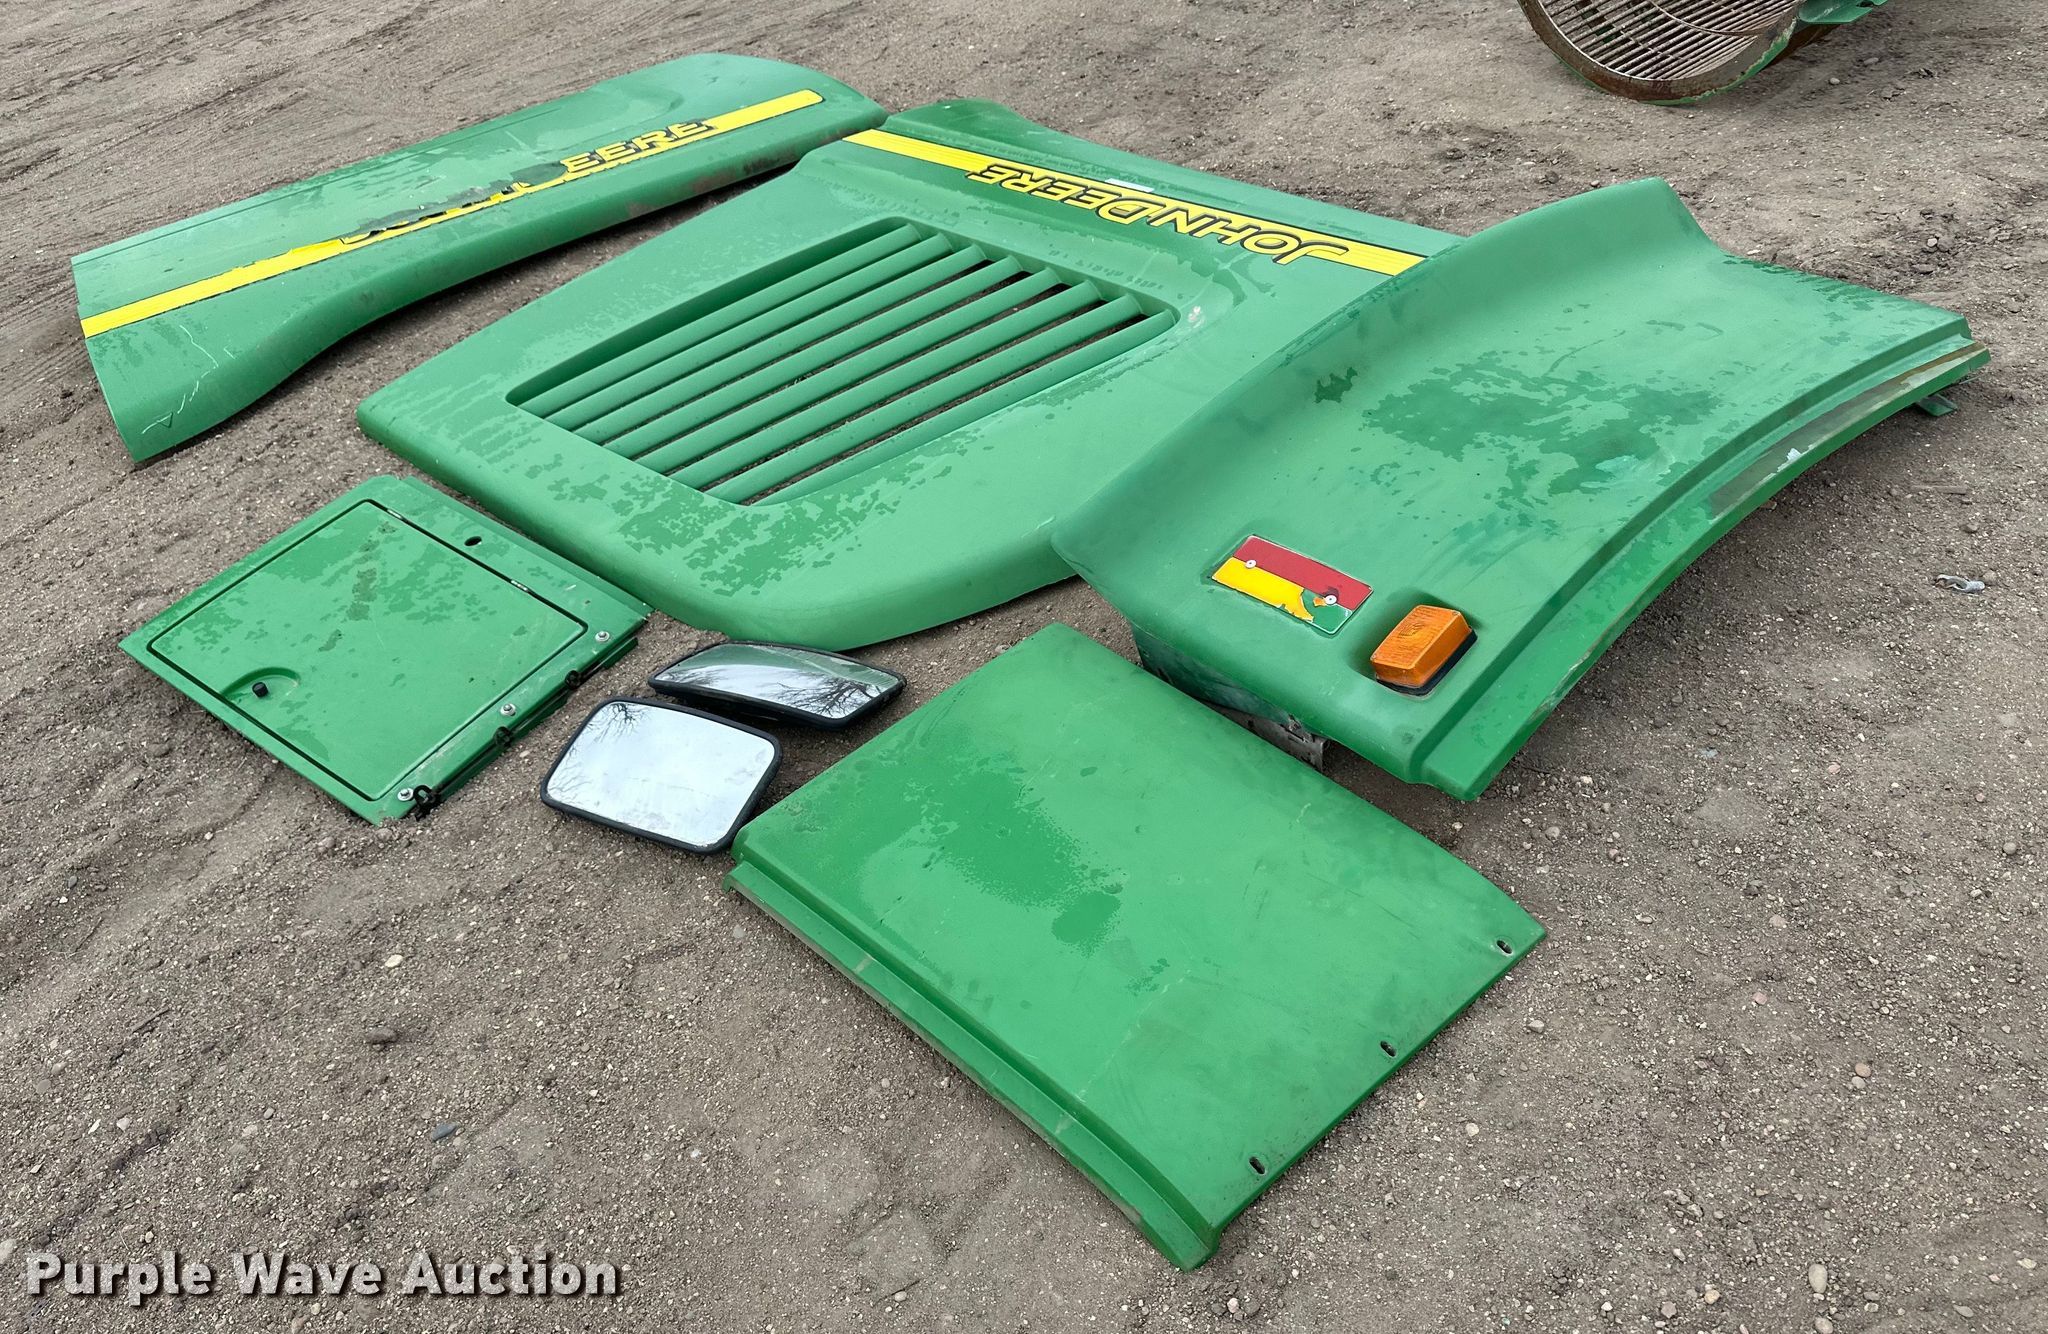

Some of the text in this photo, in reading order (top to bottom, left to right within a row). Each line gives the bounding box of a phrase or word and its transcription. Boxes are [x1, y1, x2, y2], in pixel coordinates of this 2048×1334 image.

[512, 119, 716, 187] EERE
[966, 163, 1349, 266] JOHN DEERE
